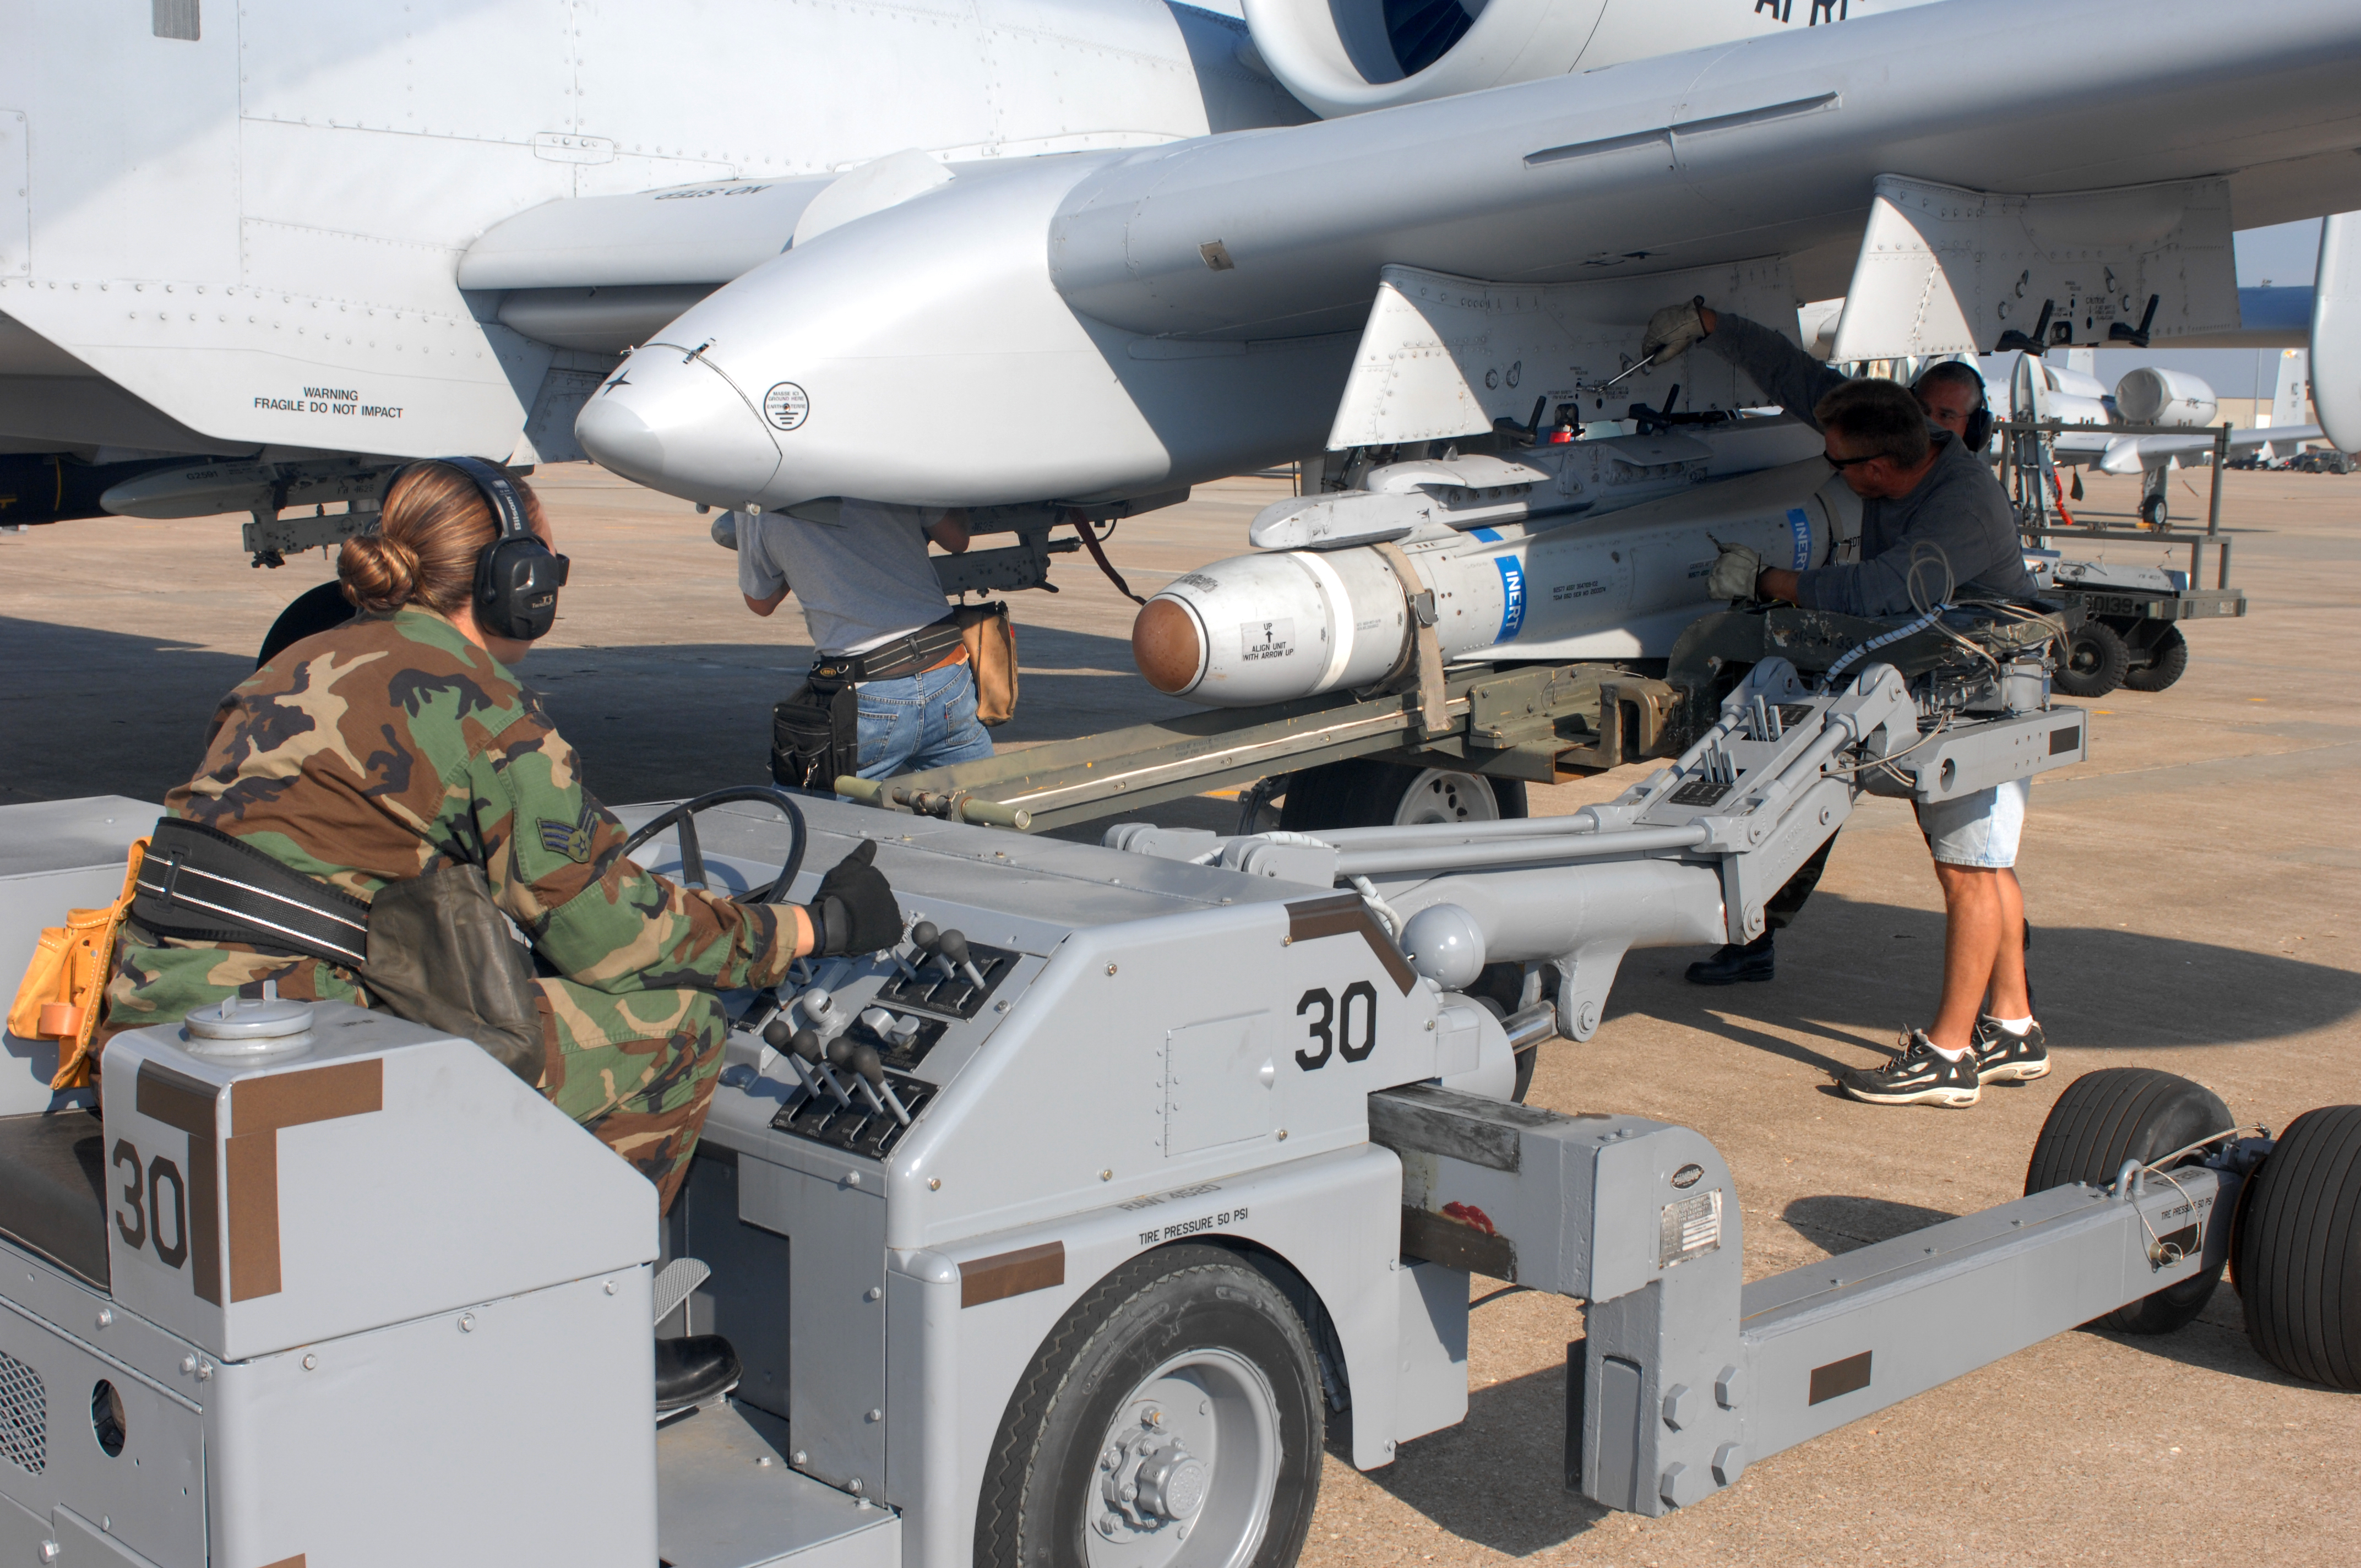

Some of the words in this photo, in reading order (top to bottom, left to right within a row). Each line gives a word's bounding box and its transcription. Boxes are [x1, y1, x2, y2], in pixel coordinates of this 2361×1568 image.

[303, 386, 358, 401] WARNING
[254, 398, 304, 412] FRAGILE
[310, 401, 328, 413] DO
[333, 403, 357, 415] NOT
[361, 405, 403, 418] IMPACT
[1794, 522, 1808, 570] INERT
[1505, 570, 1521, 629] INERT
[1252, 644, 1270, 652] ALIGN
[1273, 641, 1286, 650] UNIT
[1243, 653, 1259, 661] WITH
[1261, 650, 1283, 660] ARROW
[927, 1002, 963, 1015] OUTRIGGERS
[1295, 980, 1377, 1071] 30
[807, 1129, 820, 1137] ROLL
[843, 1141, 855, 1149] TILT
[113, 1138, 188, 1270] 30
[1117, 1196, 1165, 1211] RAW
[1169, 1184, 1222, 1199] 4520
[2161, 1208, 2171, 1221] TIRE
[1139, 1229, 1160, 1245] TIRE
[1165, 1216, 1213, 1239] PRESSURE
[1217, 1212, 1230, 1226] 50
[1233, 1207, 1248, 1222] PSI
